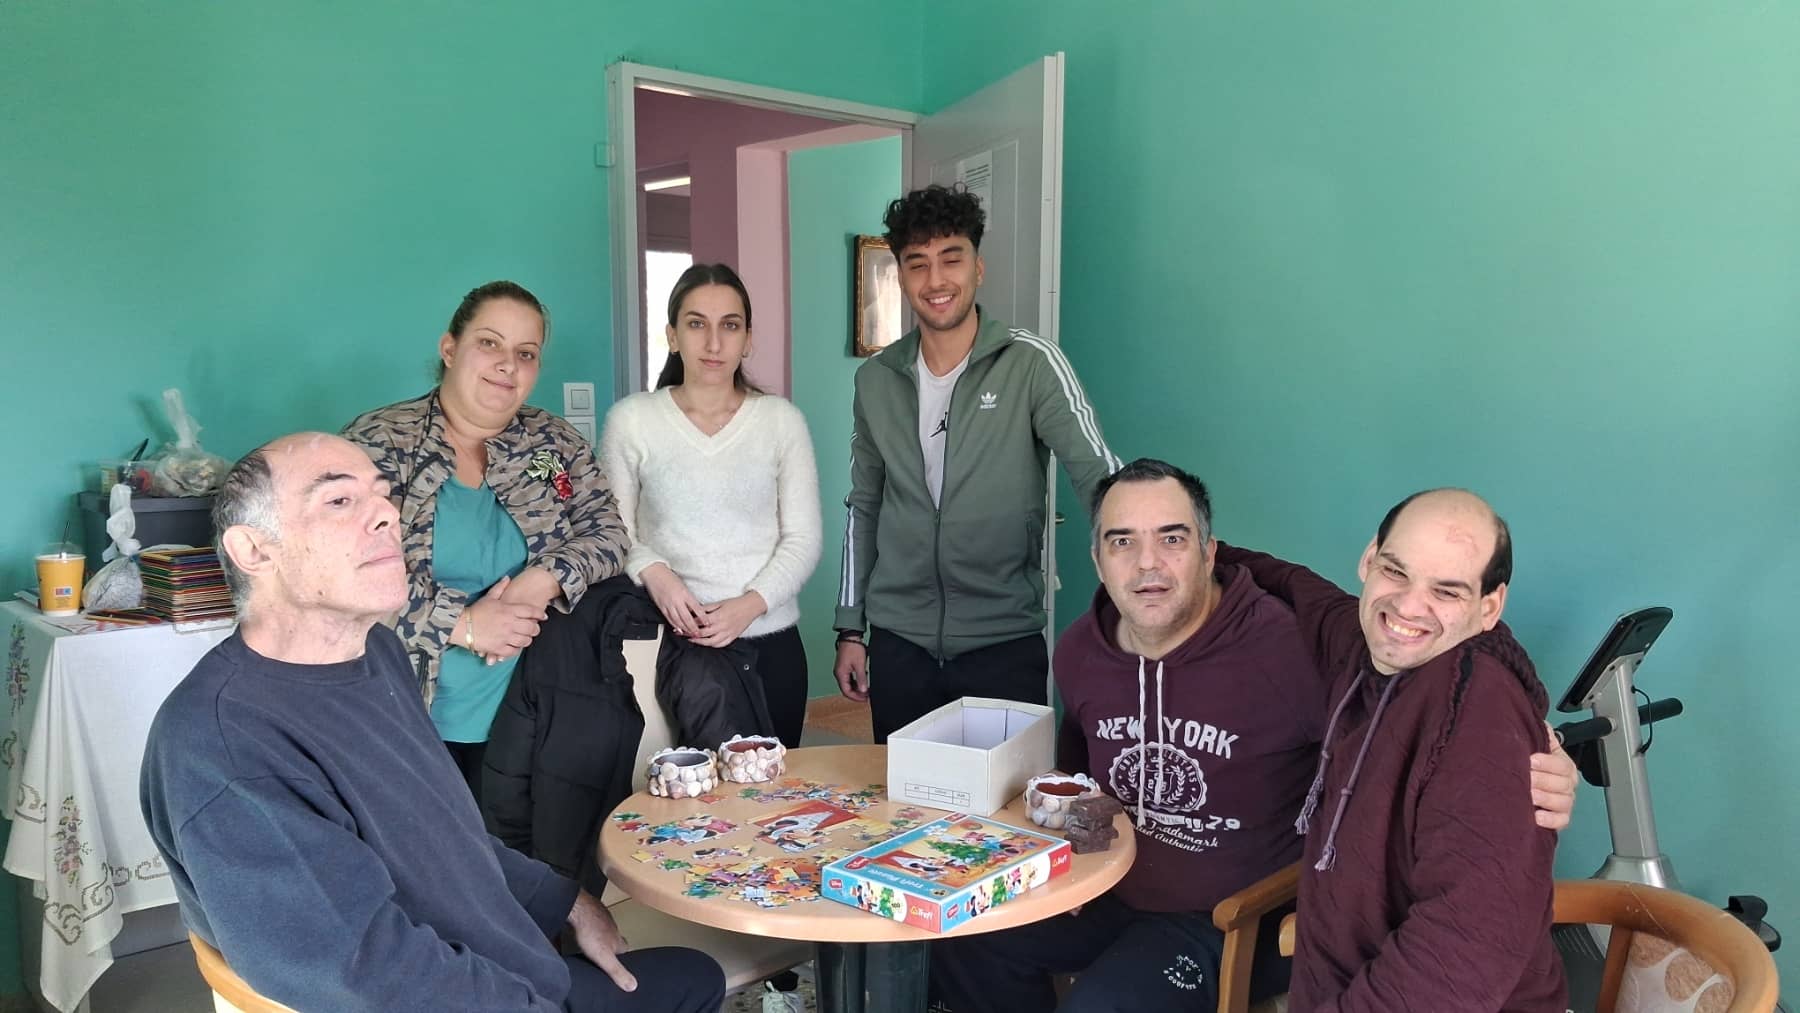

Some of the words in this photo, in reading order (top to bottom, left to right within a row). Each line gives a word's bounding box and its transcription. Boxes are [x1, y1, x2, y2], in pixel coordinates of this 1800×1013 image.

[1097, 715, 1146, 740] NEW
[1163, 717, 1239, 760] YORK
[1149, 820, 1218, 848] Trademark
[1154, 833, 1204, 853] Authentic
